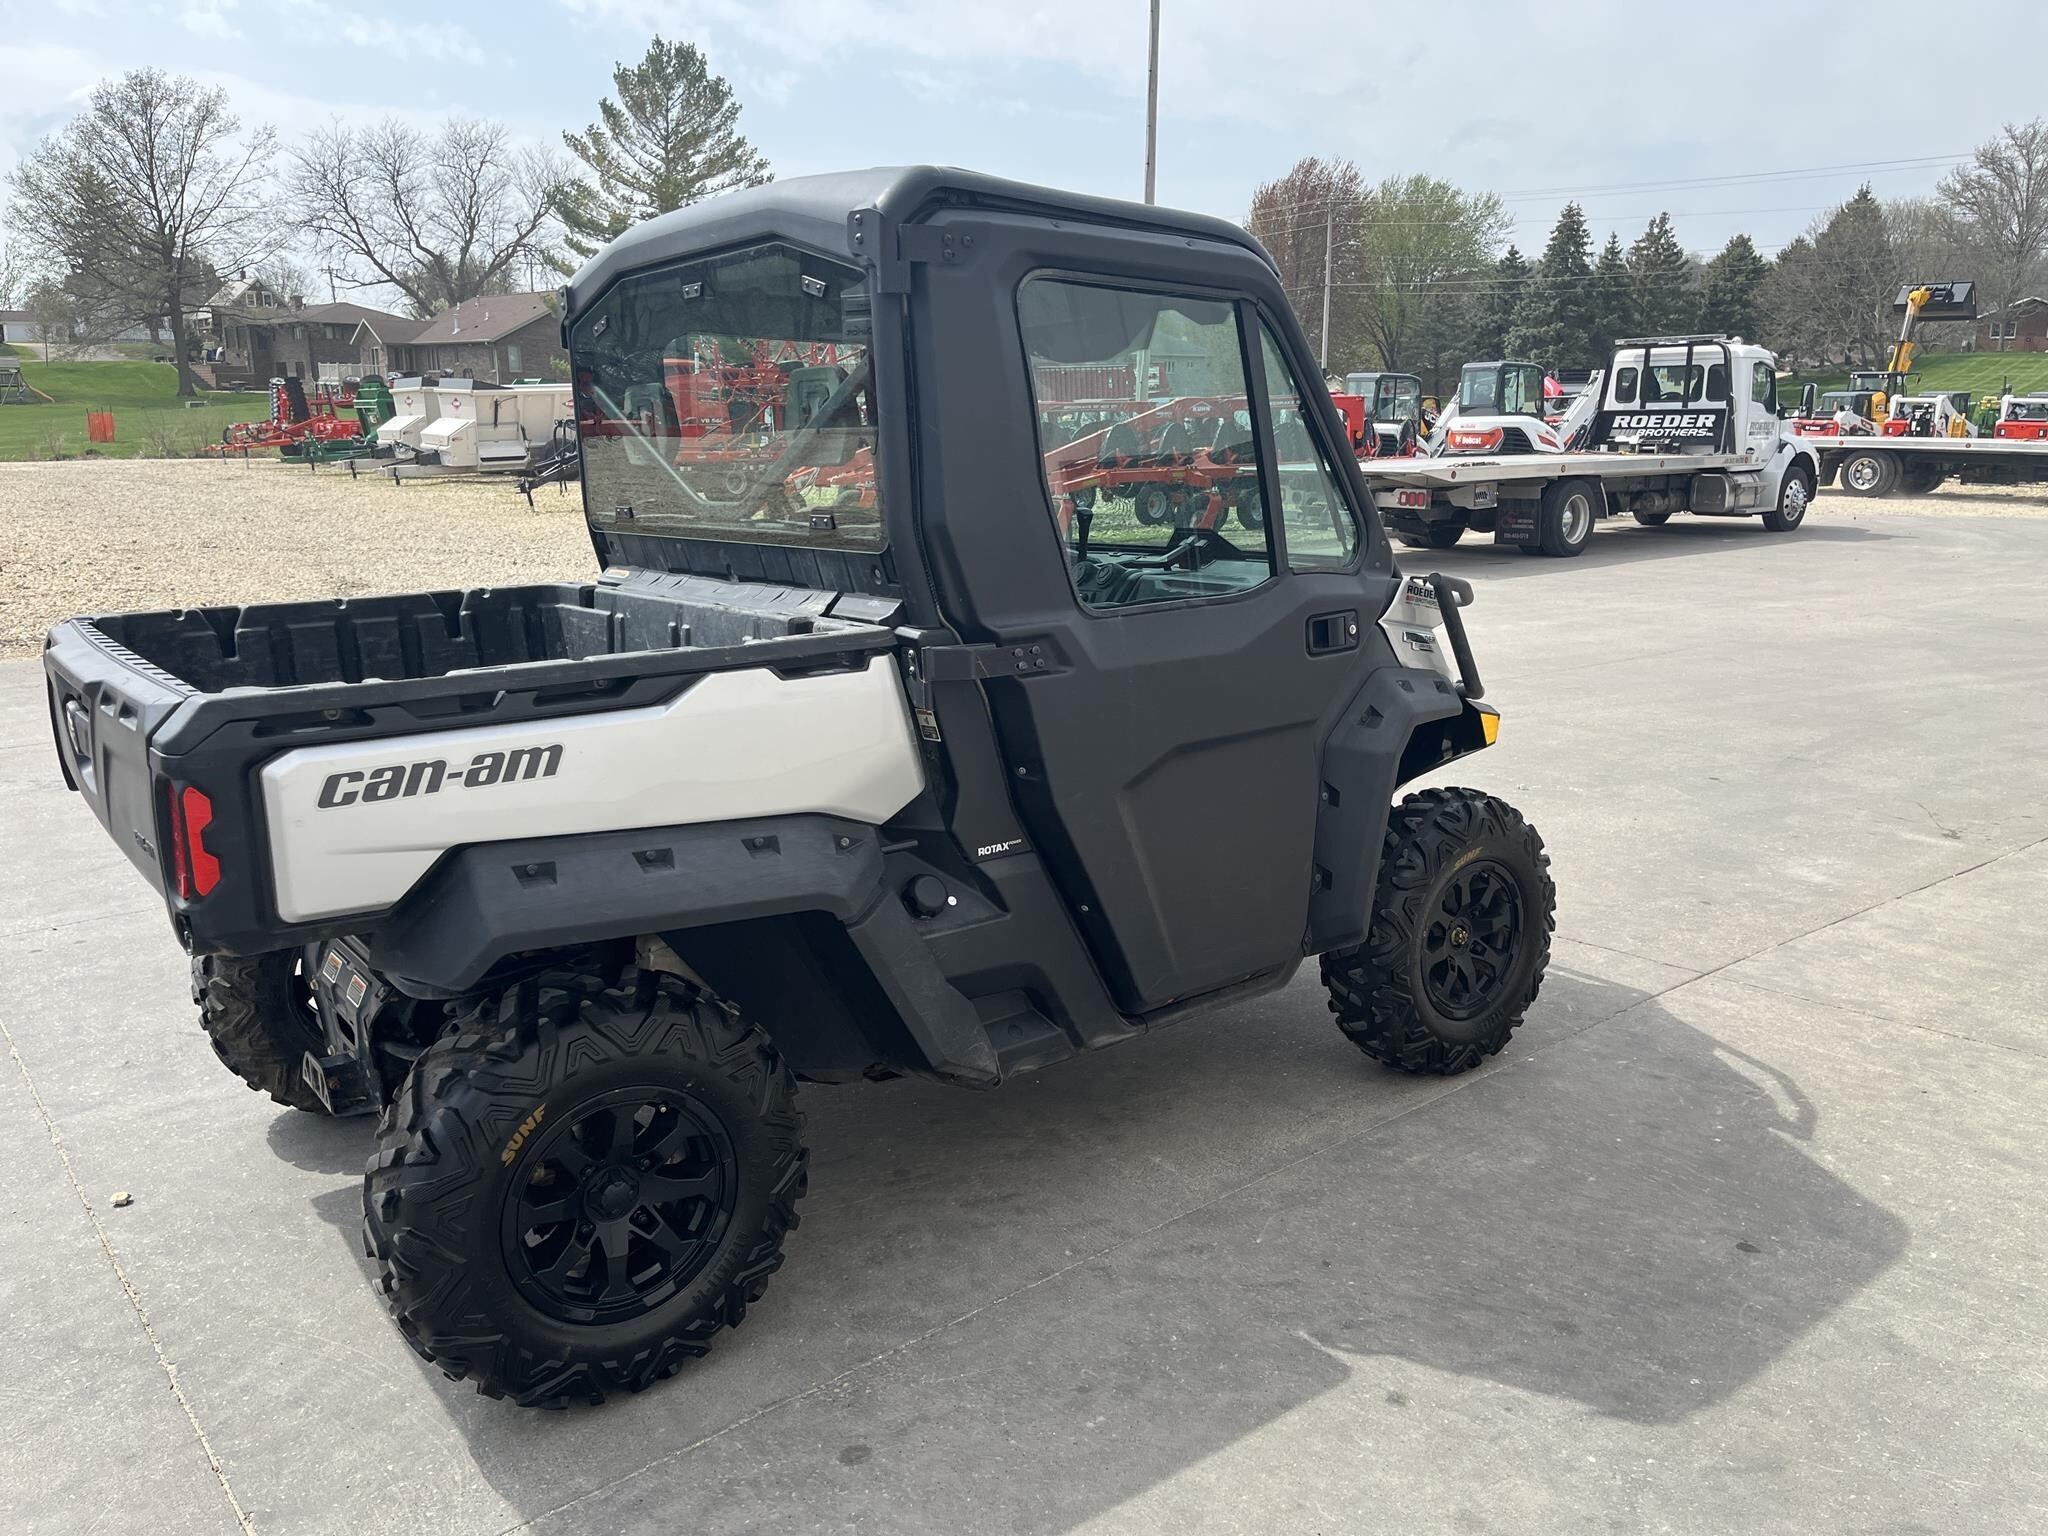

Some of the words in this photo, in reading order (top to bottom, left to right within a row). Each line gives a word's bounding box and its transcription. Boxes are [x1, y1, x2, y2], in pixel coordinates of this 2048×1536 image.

[1612, 414, 1716, 428] ROEDER
[1636, 428, 1708, 436] BROTHERS
[1461, 436, 1482, 445] Bobcat
[1407, 585, 1437, 600] ROEDE
[316, 744, 564, 809] can-am
[978, 842, 1009, 856] ROTAX
